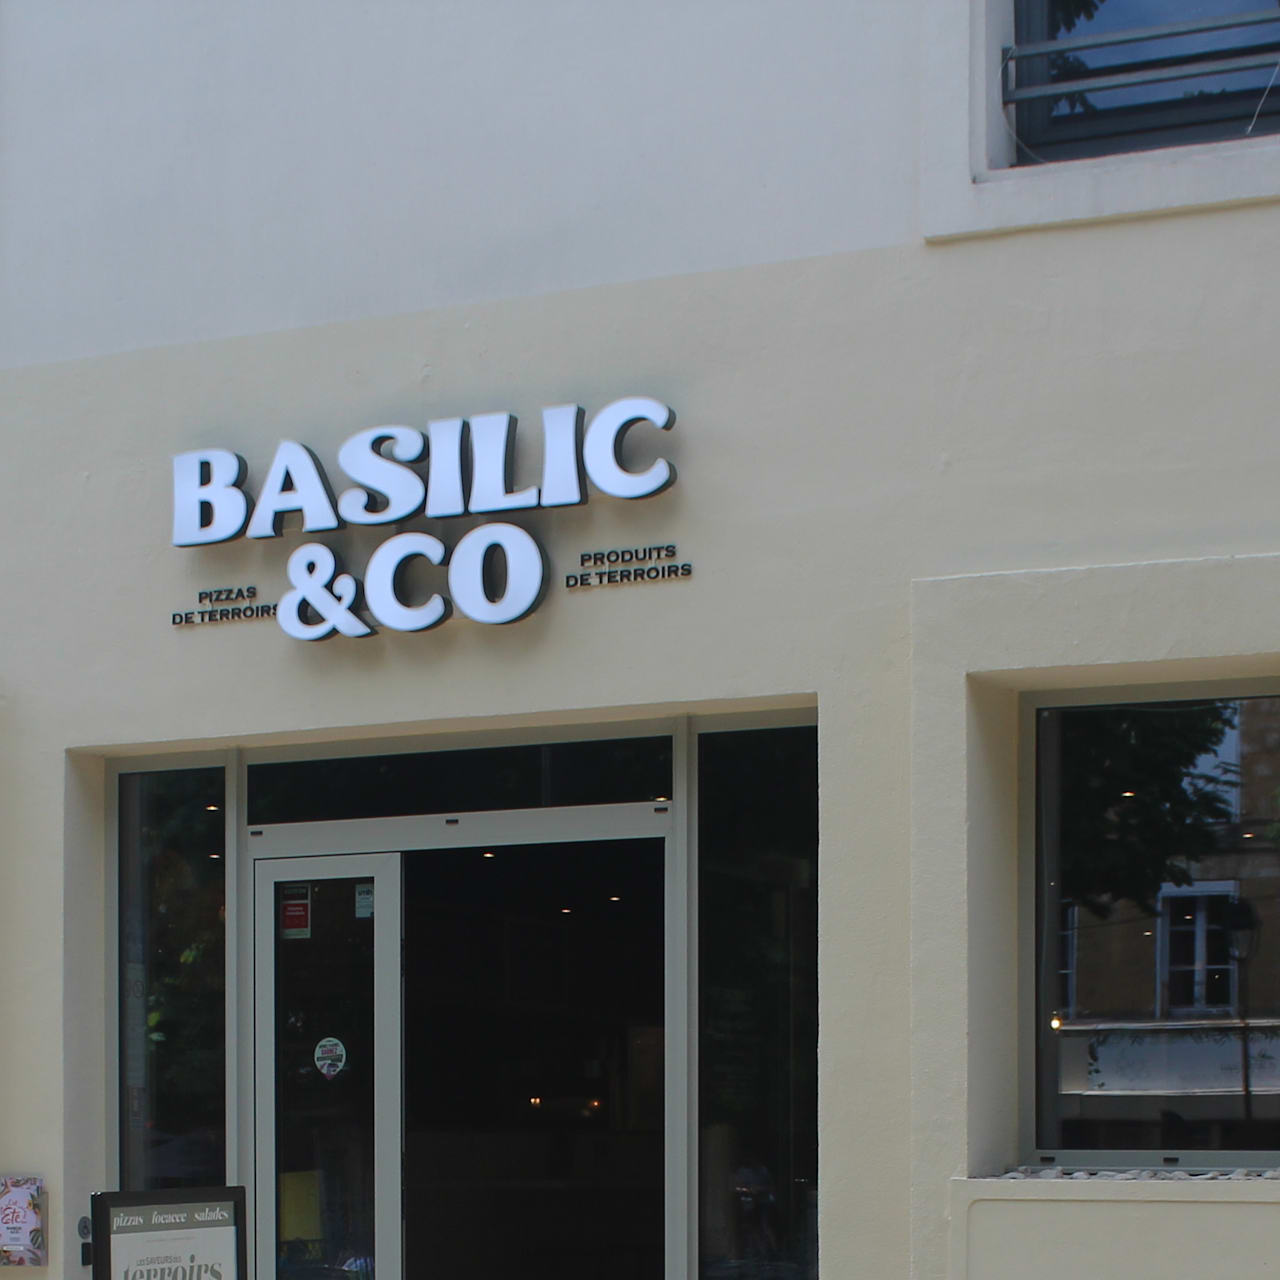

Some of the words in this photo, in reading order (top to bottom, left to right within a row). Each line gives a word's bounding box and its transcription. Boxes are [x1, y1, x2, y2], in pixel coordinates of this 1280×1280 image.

[172, 397, 676, 547] BASILIC
[580, 544, 677, 567] PRODUITS
[276, 522, 550, 641] &CO
[565, 573, 592, 588] DE
[595, 563, 693, 585] TERROIRS
[198, 586, 257, 604] PIZZAS
[172, 611, 195, 625] DE
[113, 1213, 144, 1231] pizzas
[195, 1207, 229, 1222] salades
